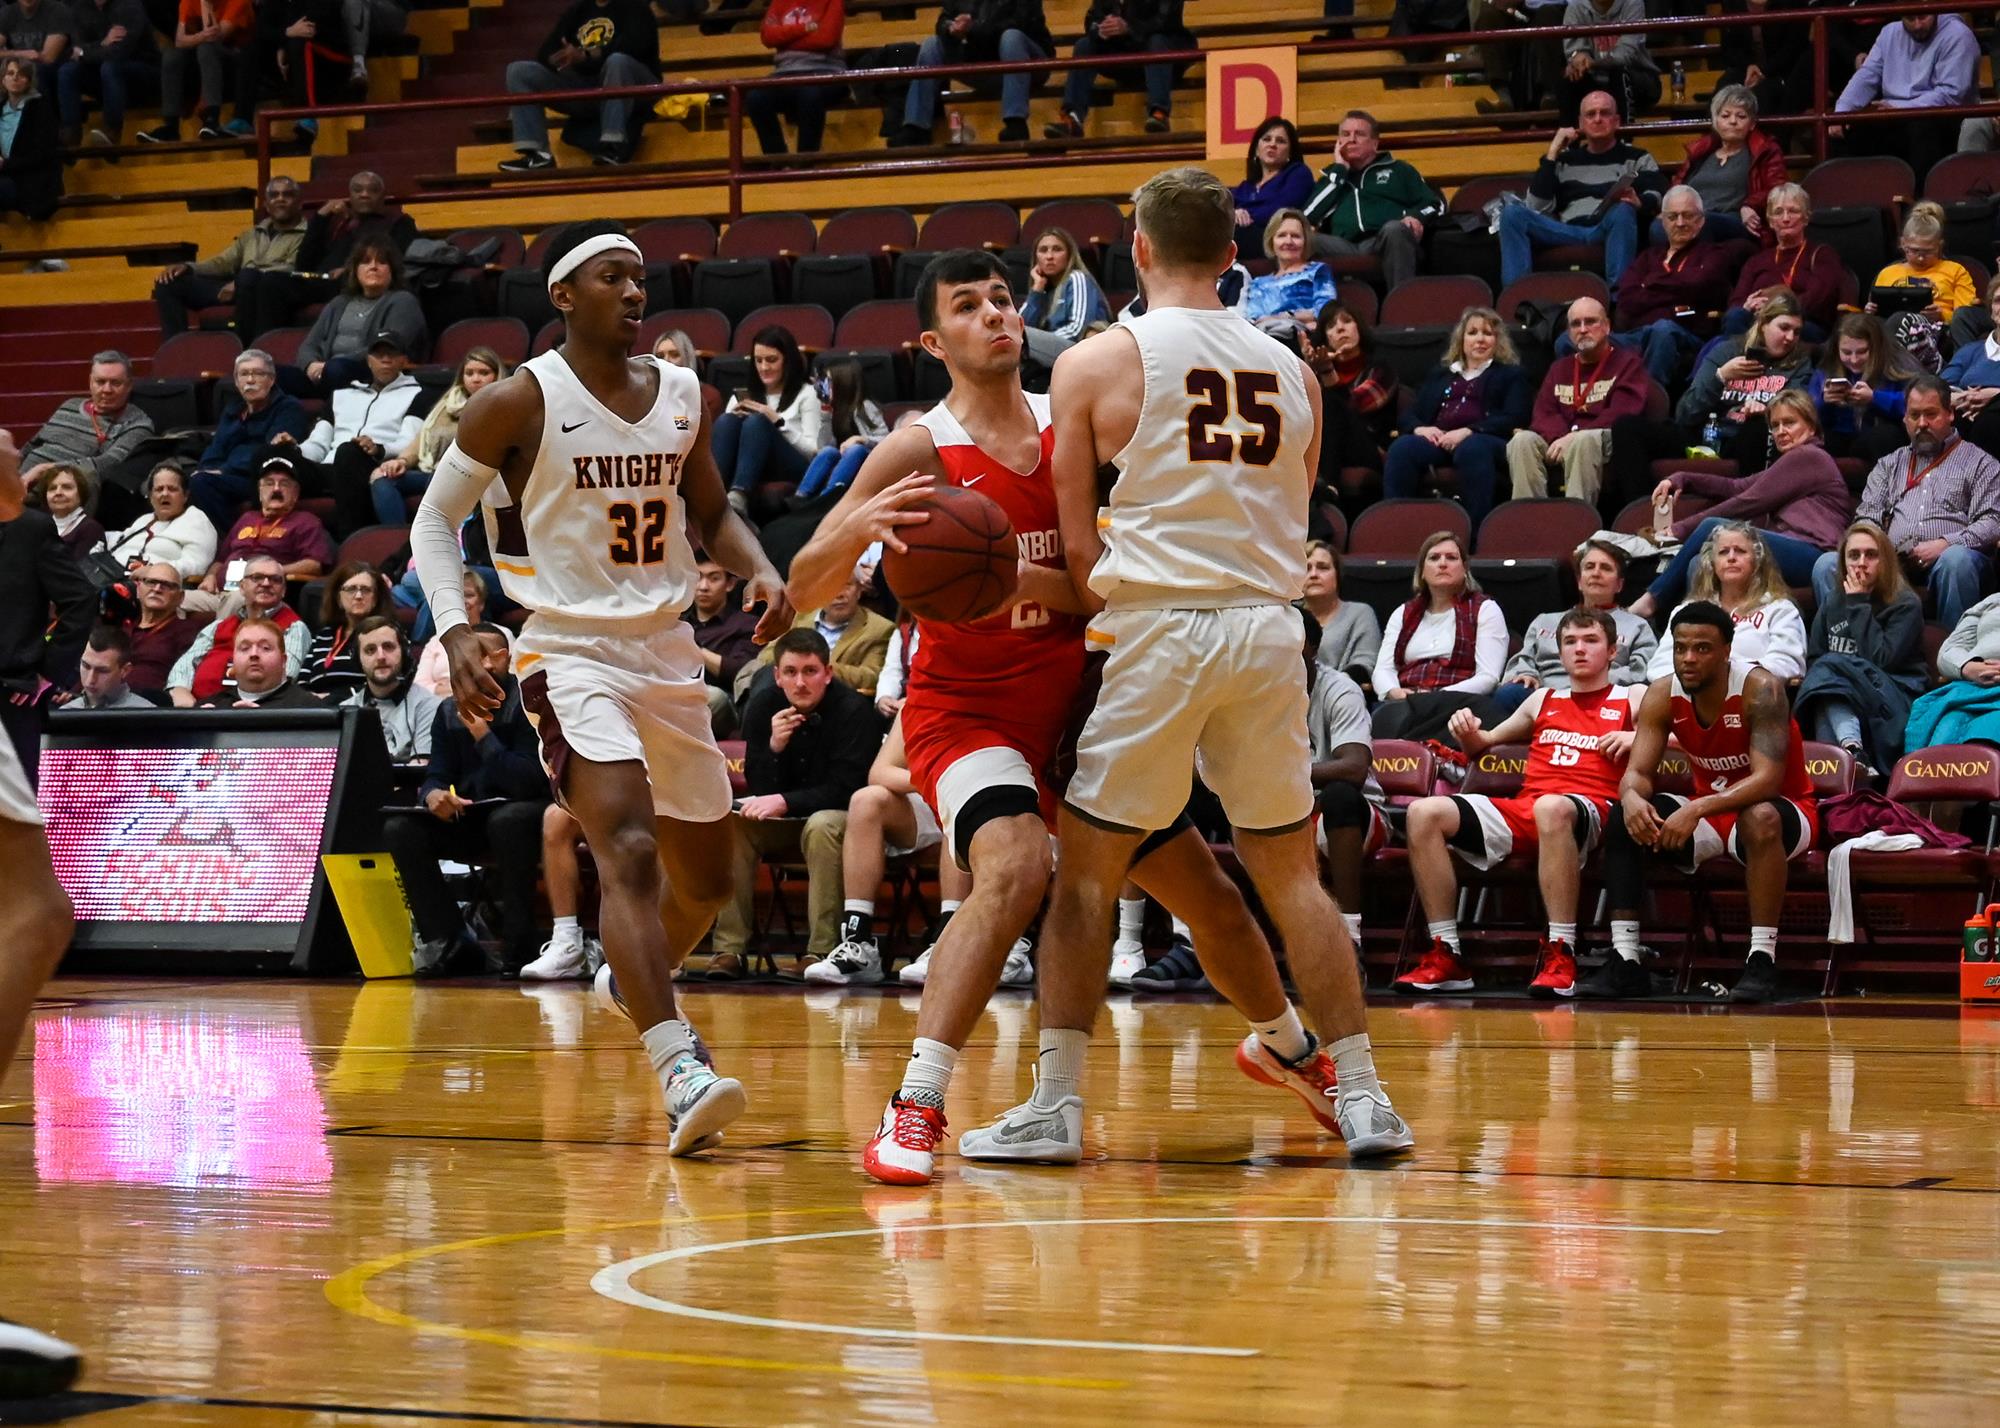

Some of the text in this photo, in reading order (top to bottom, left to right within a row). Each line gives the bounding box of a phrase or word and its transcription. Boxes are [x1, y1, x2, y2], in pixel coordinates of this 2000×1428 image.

[1220, 62, 1283, 145] D
[1183, 367, 1284, 468] 25
[607, 497, 669, 566] 32
[1539, 728, 1599, 751] EDINBOR
[1372, 757, 1420, 773] NNON
[1548, 745, 1580, 766] 15
[1804, 759, 1840, 775] NON
[1904, 759, 1990, 778] GANNON
